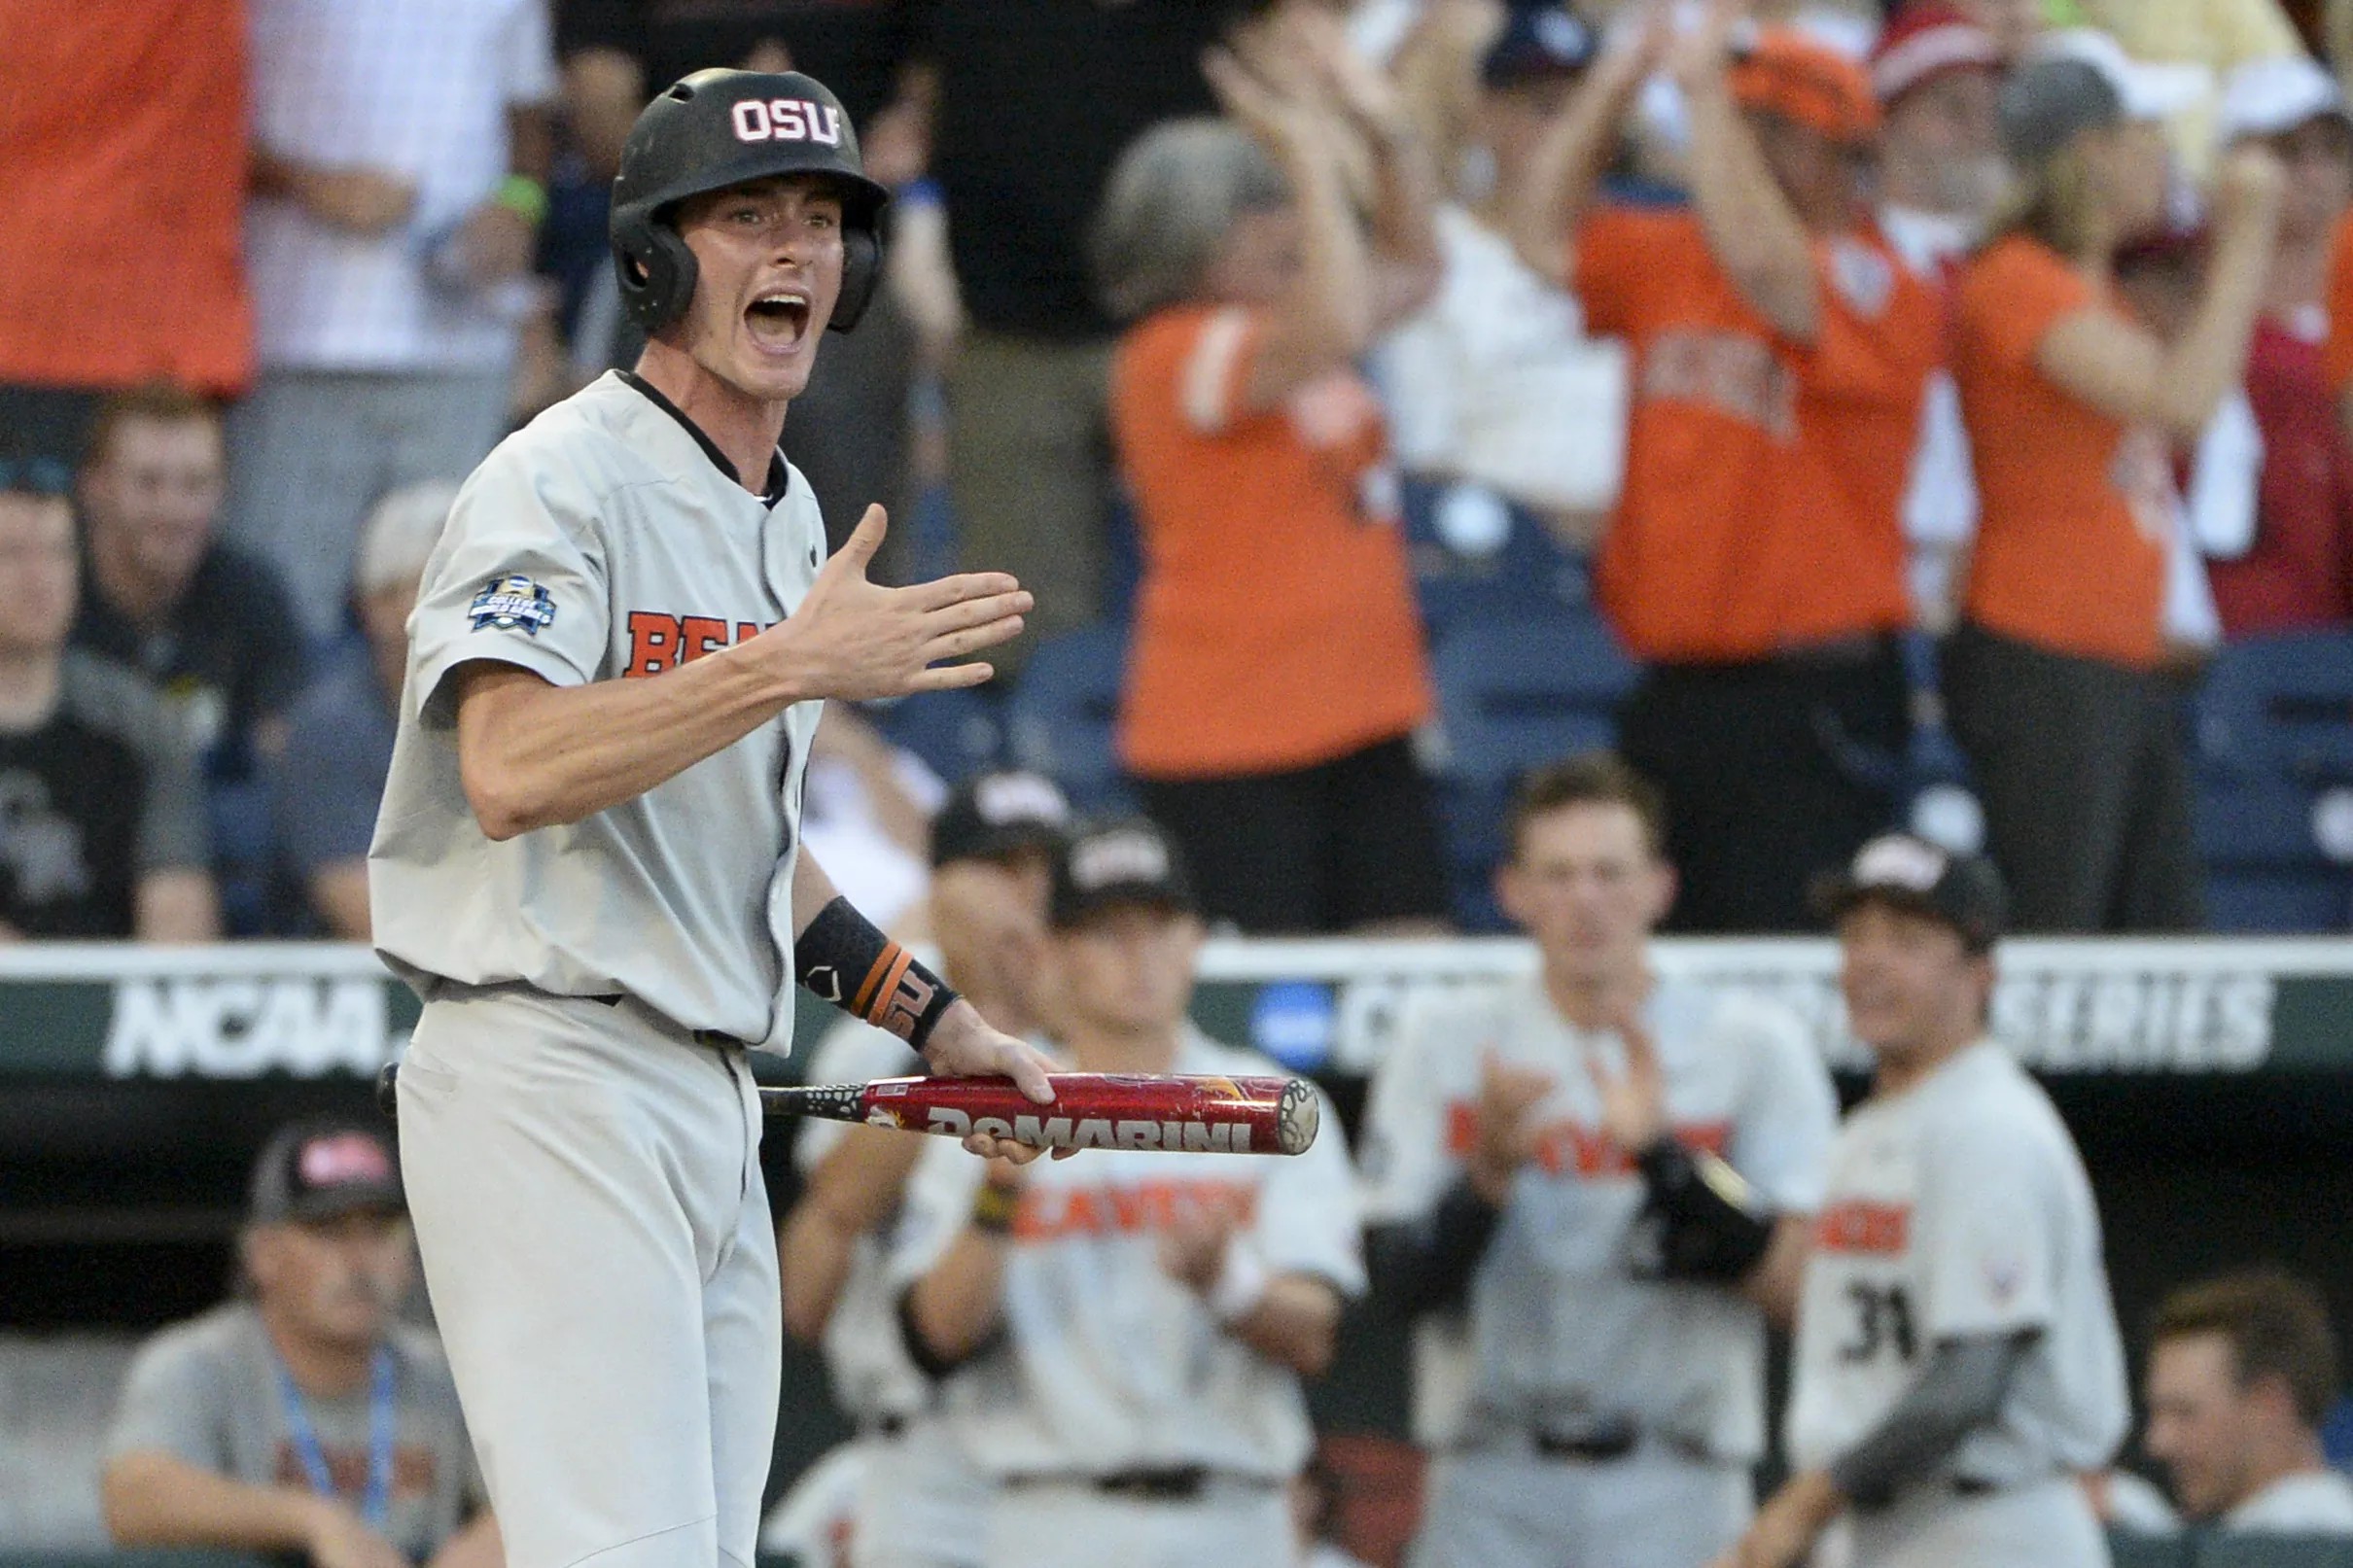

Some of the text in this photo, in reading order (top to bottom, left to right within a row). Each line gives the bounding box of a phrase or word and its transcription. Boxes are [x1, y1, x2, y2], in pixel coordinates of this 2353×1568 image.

[732, 99, 840, 145] OSU
[105, 979, 388, 1081] NCAA
[927, 1105, 1252, 1153] DeMARINI
